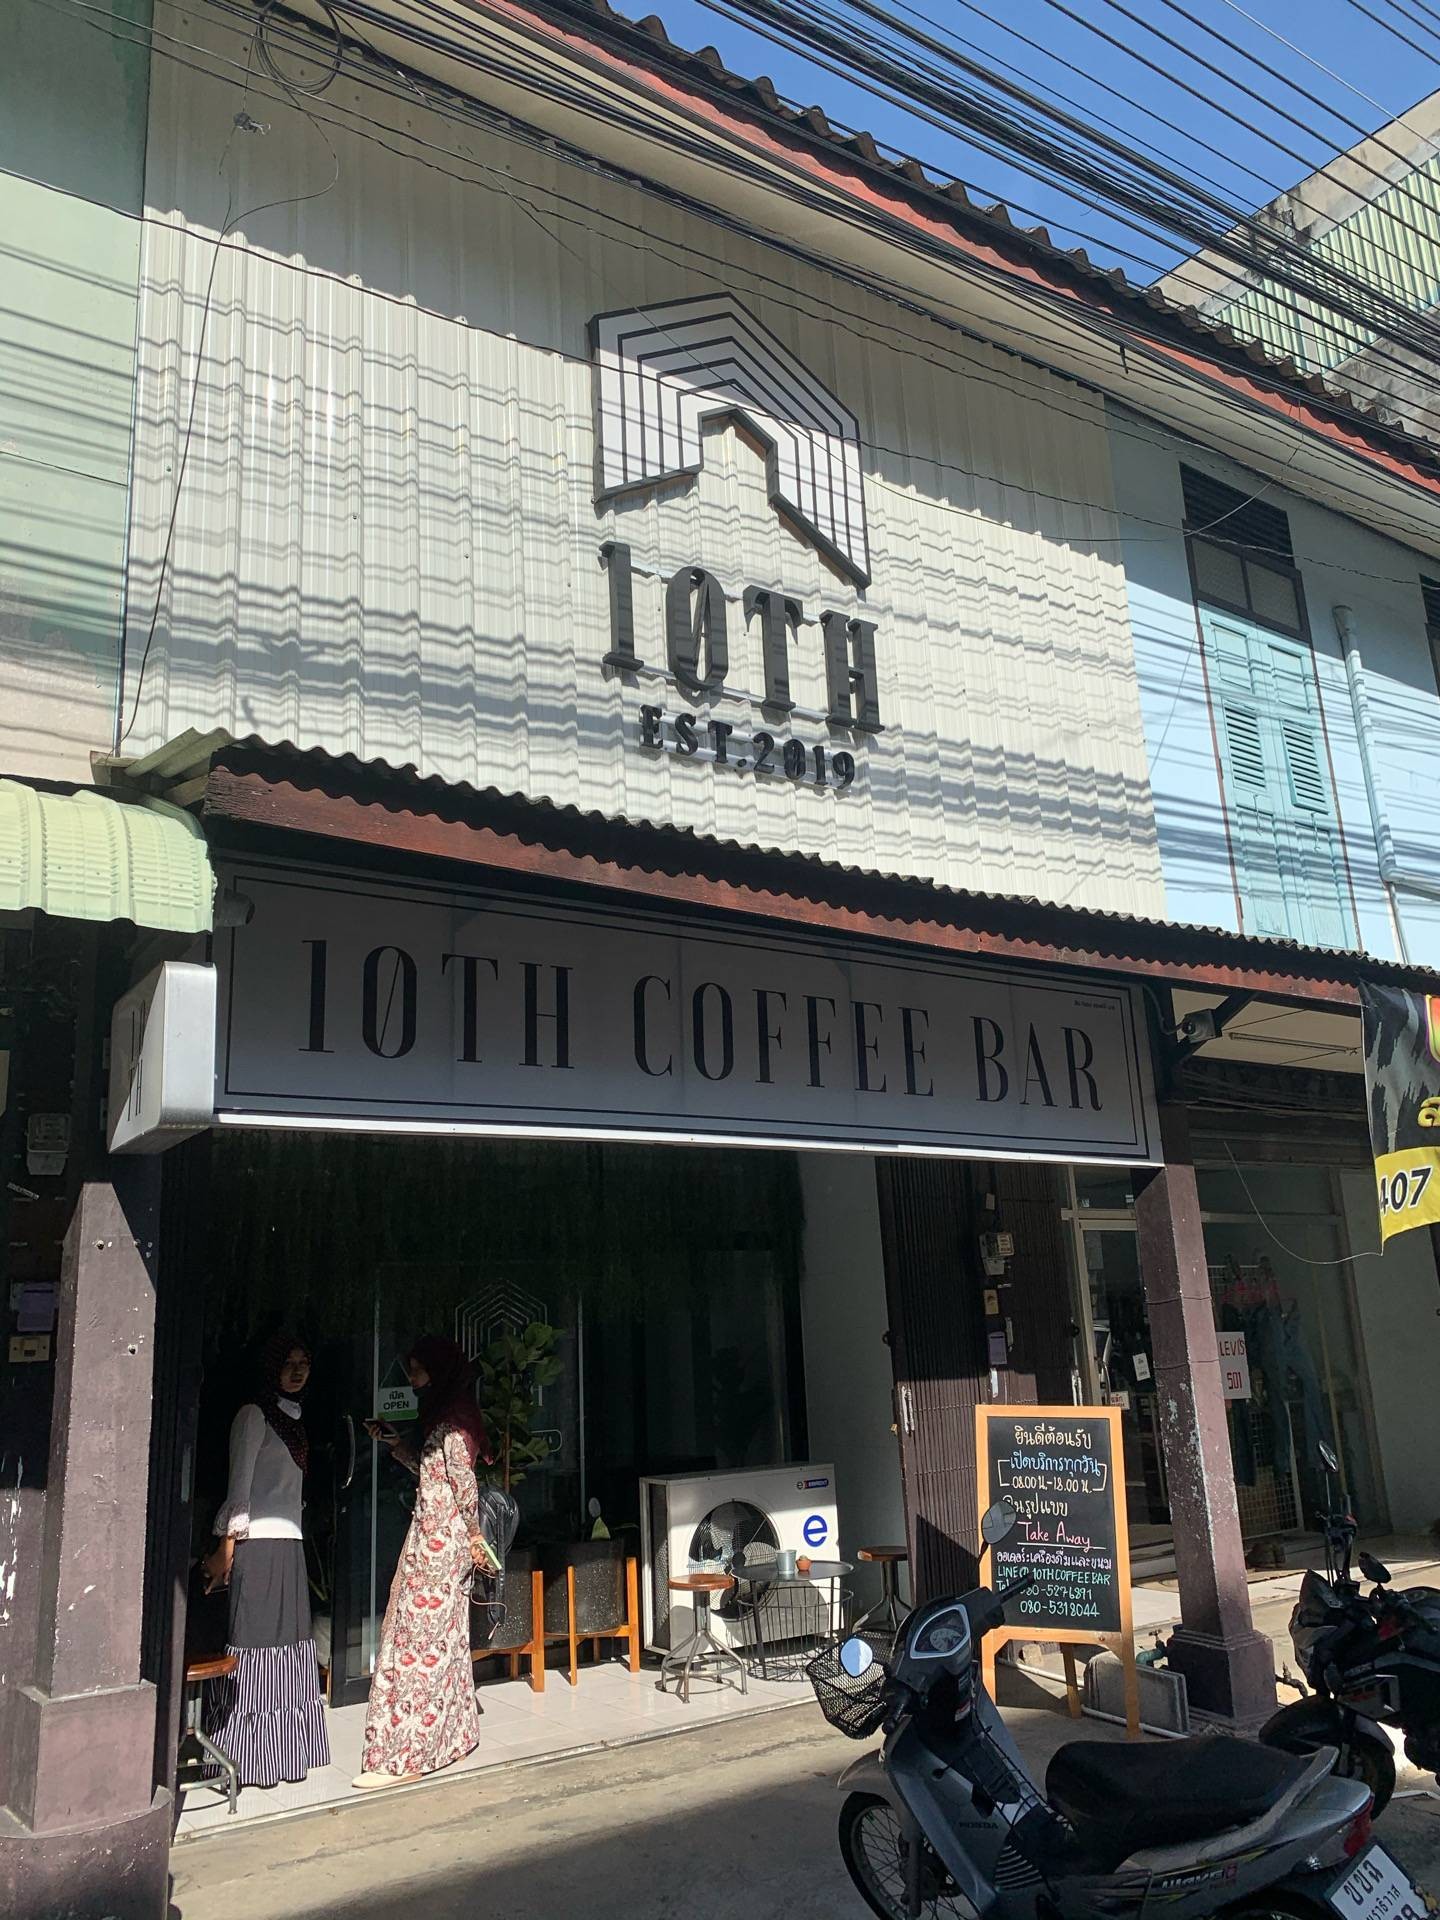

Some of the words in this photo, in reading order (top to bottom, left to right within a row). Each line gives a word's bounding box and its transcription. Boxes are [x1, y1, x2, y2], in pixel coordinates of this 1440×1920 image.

[599, 540, 885, 734] 10TH
[640, 704, 855, 790] EST.2019
[298, 939, 575, 1069] 10TH
[633, 974, 934, 1097] COFFEE
[969, 1014, 1104, 1112] BAR
[383, 1400, 410, 1410] OPEN
[1014, 1422, 1092, 1449] ยินดีต้อนรับ
[1010, 1450, 1101, 1477] เปิดบริการทุกวัน
[1017, 1521, 1050, 1542] Take
[1056, 1521, 1091, 1553] Away
[1020, 1600, 1101, 1618] 080-5318044
